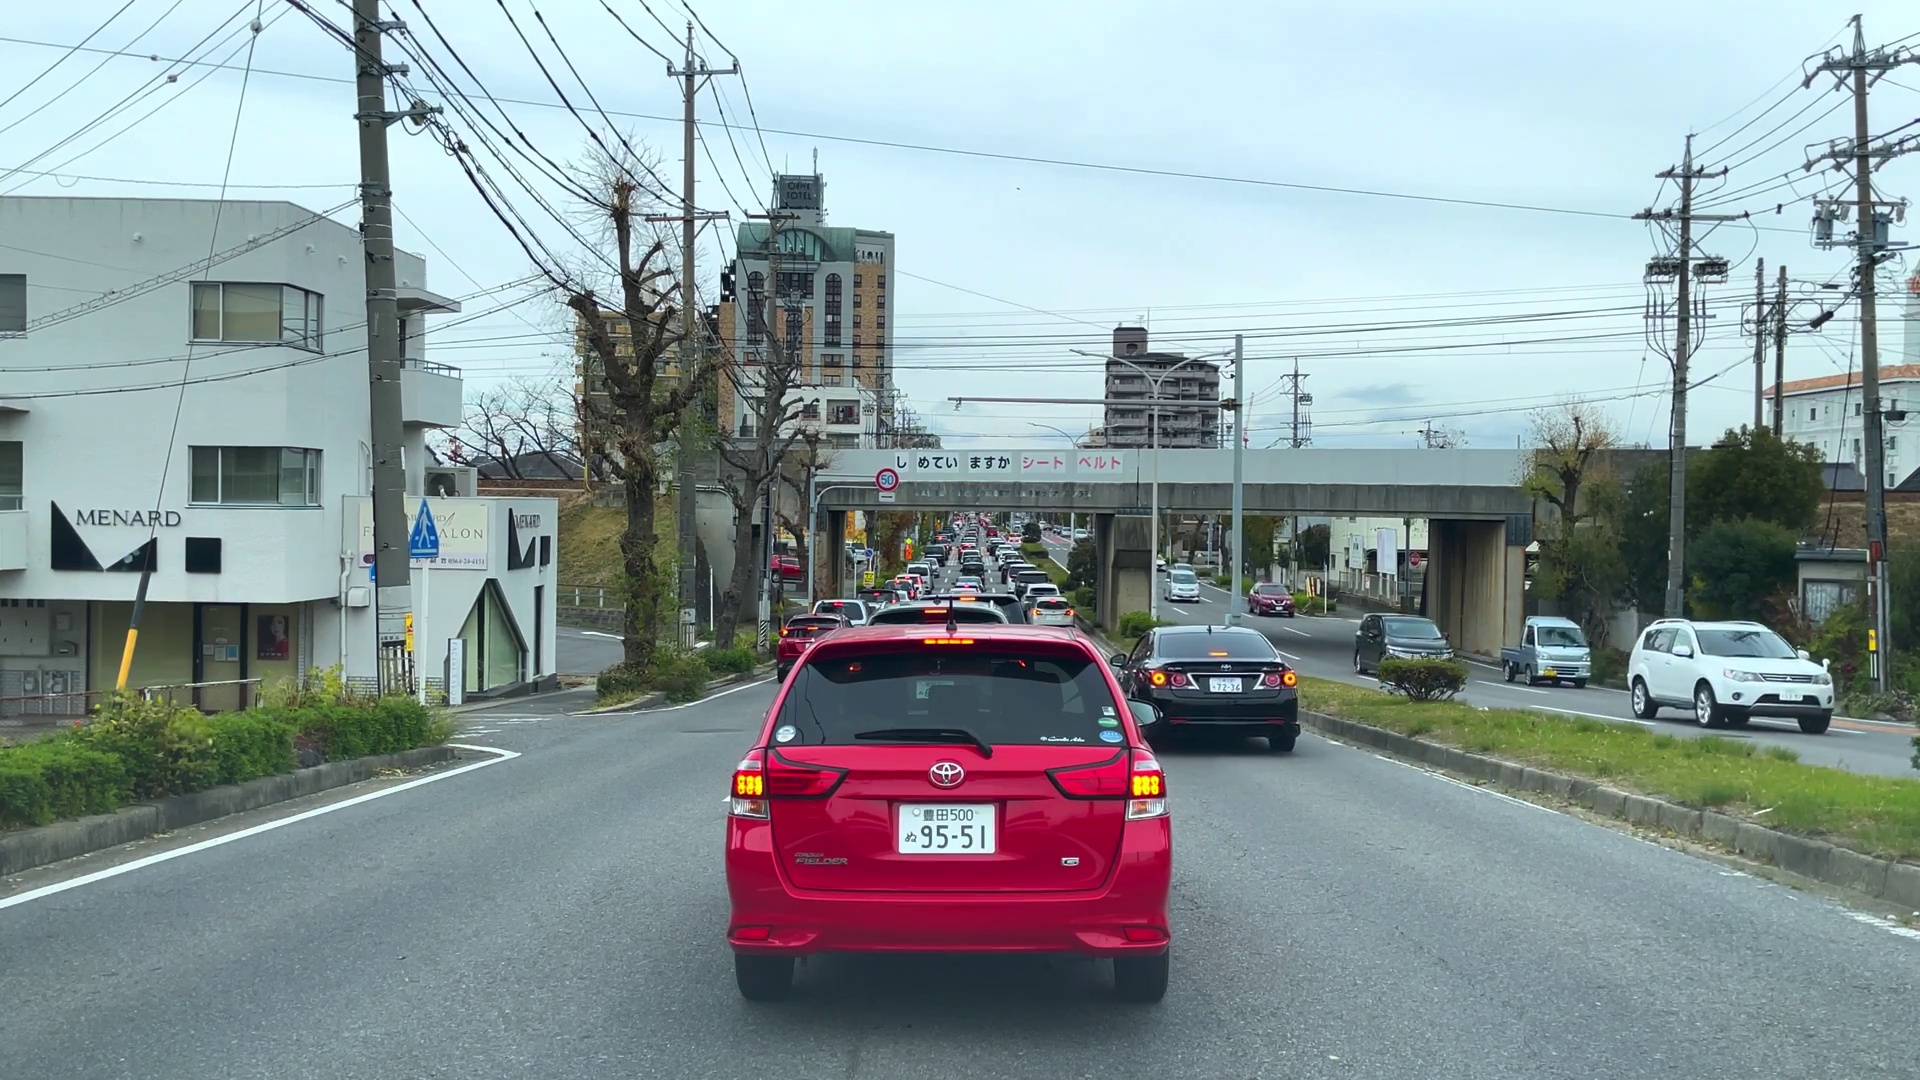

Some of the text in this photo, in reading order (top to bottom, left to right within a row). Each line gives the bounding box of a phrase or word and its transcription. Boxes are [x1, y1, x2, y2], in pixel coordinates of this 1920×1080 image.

[917, 456, 958, 469] めてい
[969, 456, 1010, 469] ますか
[1022, 456, 1063, 469] シート
[1078, 456, 1121, 470] ベルト
[880, 474, 894, 485] 50
[76, 509, 182, 528] MENARD
[923, 808, 974, 822] 豊田500
[920, 825, 985, 849] 95-51
